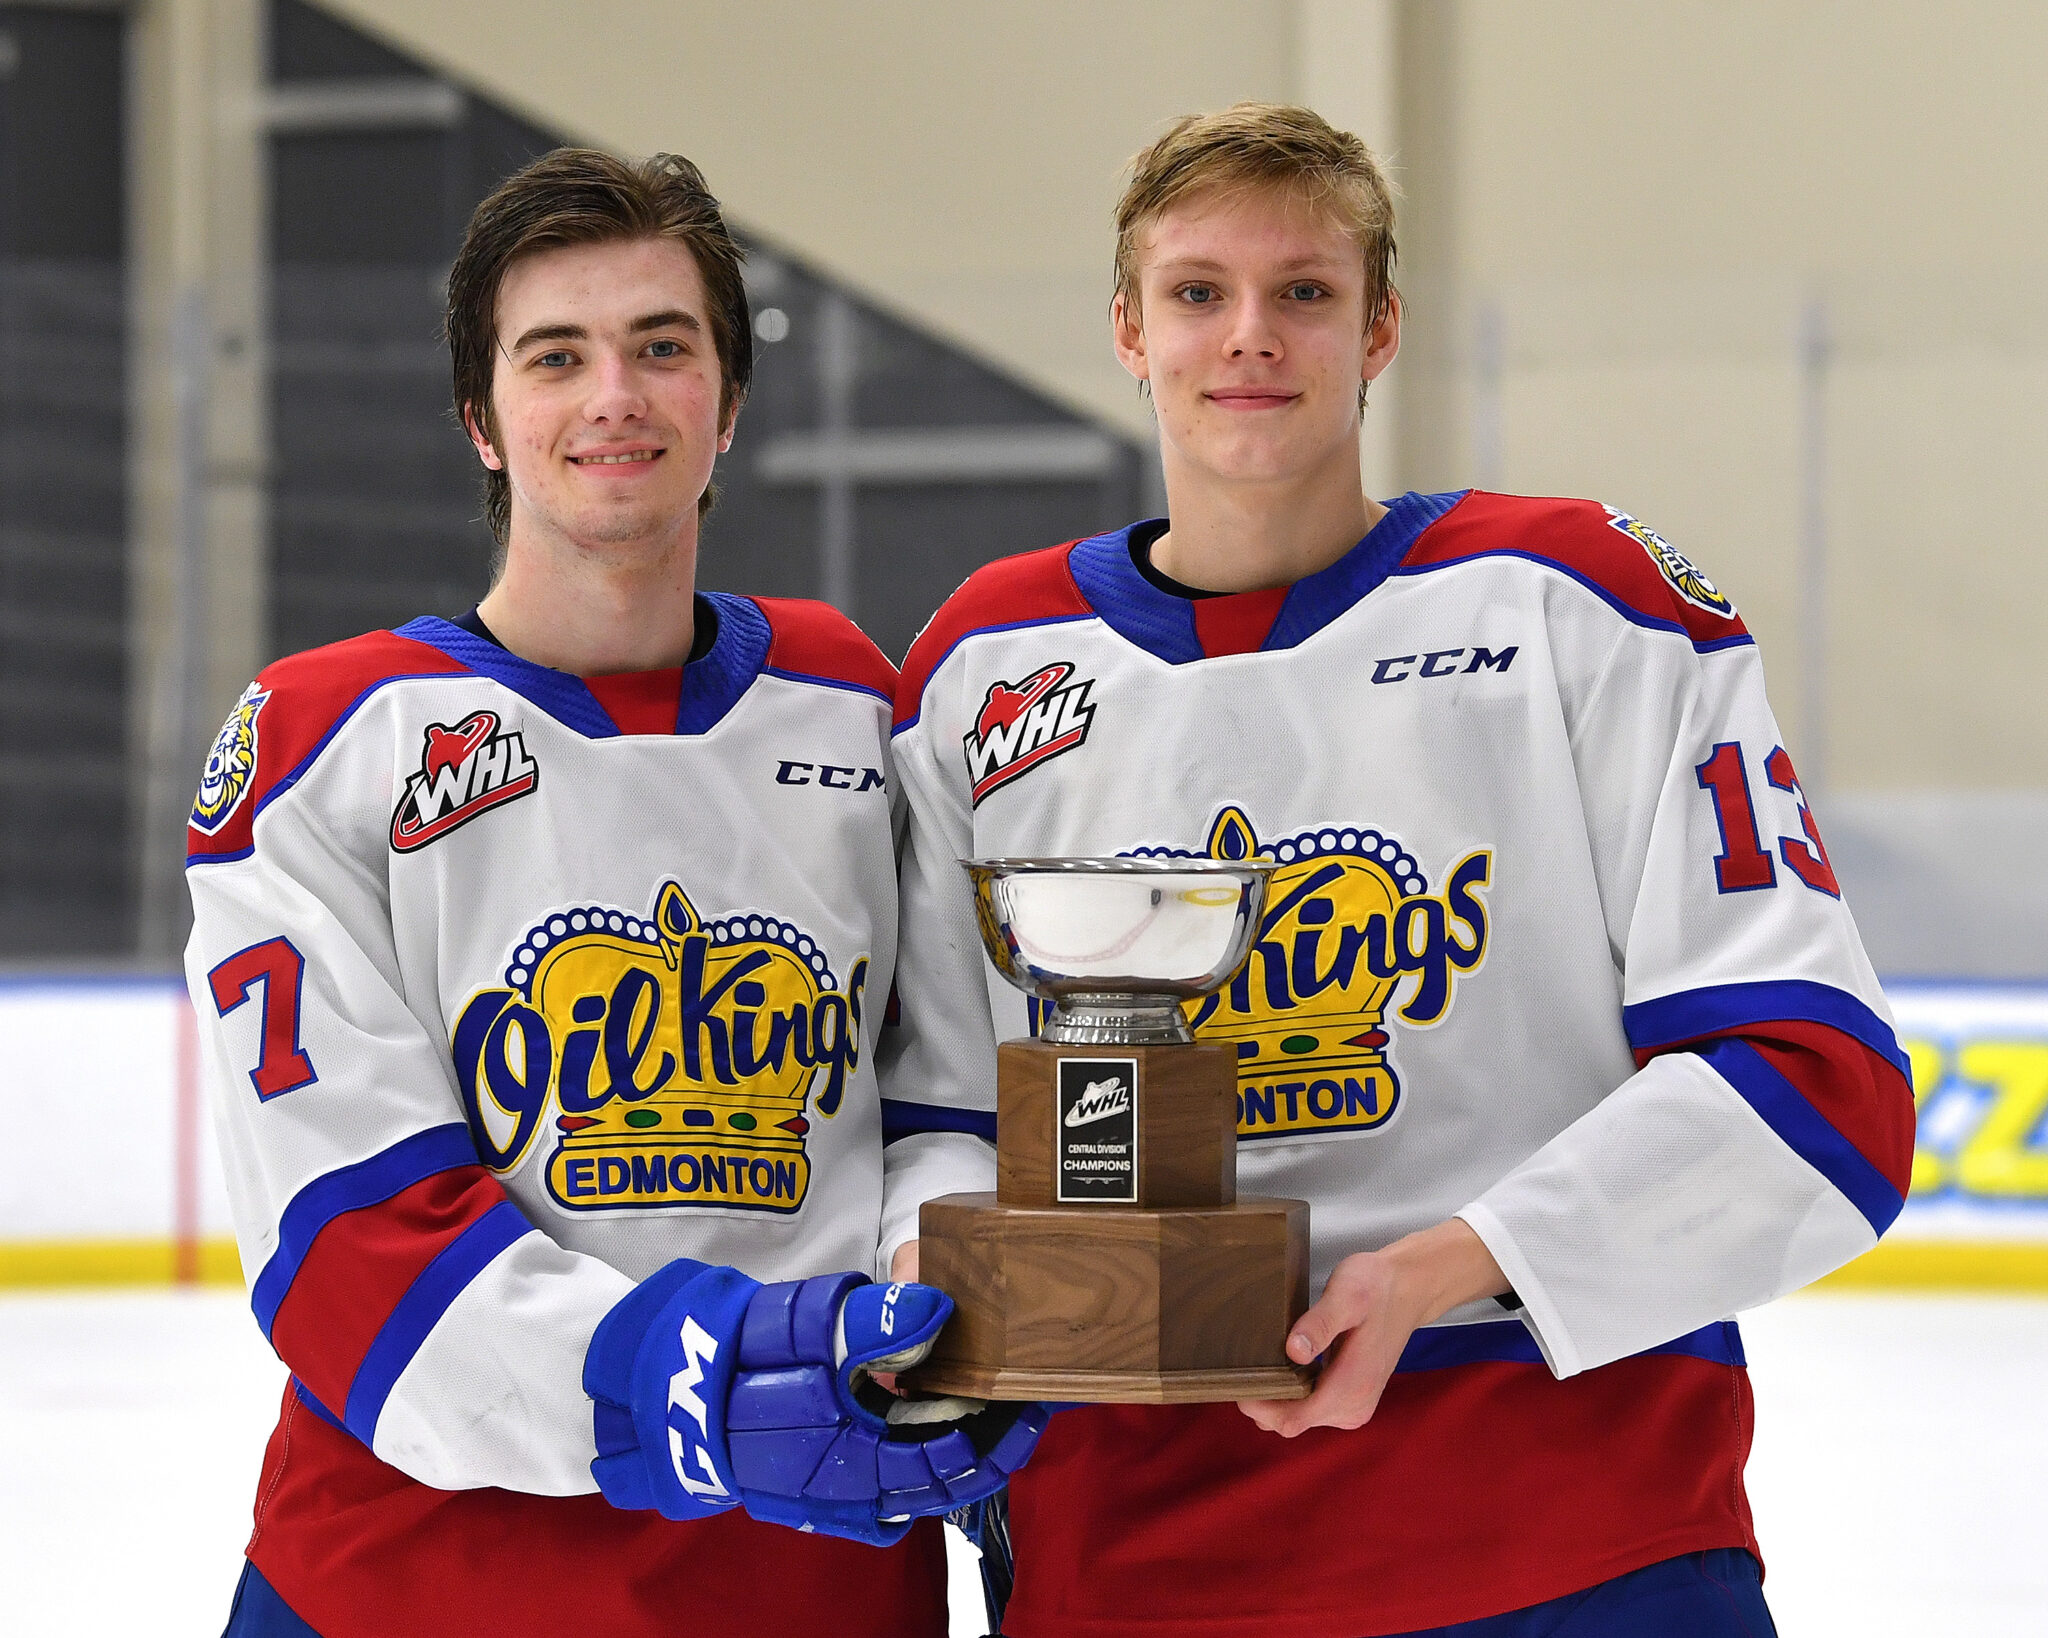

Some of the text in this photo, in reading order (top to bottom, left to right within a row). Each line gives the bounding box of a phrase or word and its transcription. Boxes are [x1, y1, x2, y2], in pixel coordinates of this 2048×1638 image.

[1371, 646, 1519, 685] CCM
[965, 682, 1092, 785] WHL
[409, 734, 537, 826] WHL
[775, 760, 887, 794] CCM
[1695, 741, 1841, 899] 13
[207, 935, 319, 1103] 7
[1075, 1086, 1129, 1119] WHL
[1063, 1160, 1131, 1171] CHAMPIONS
[1068, 1144, 1126, 1154] CENTRAL DIVISION
[565, 1153, 797, 1200] EDMONTON
[667, 1314, 742, 1505] CM
